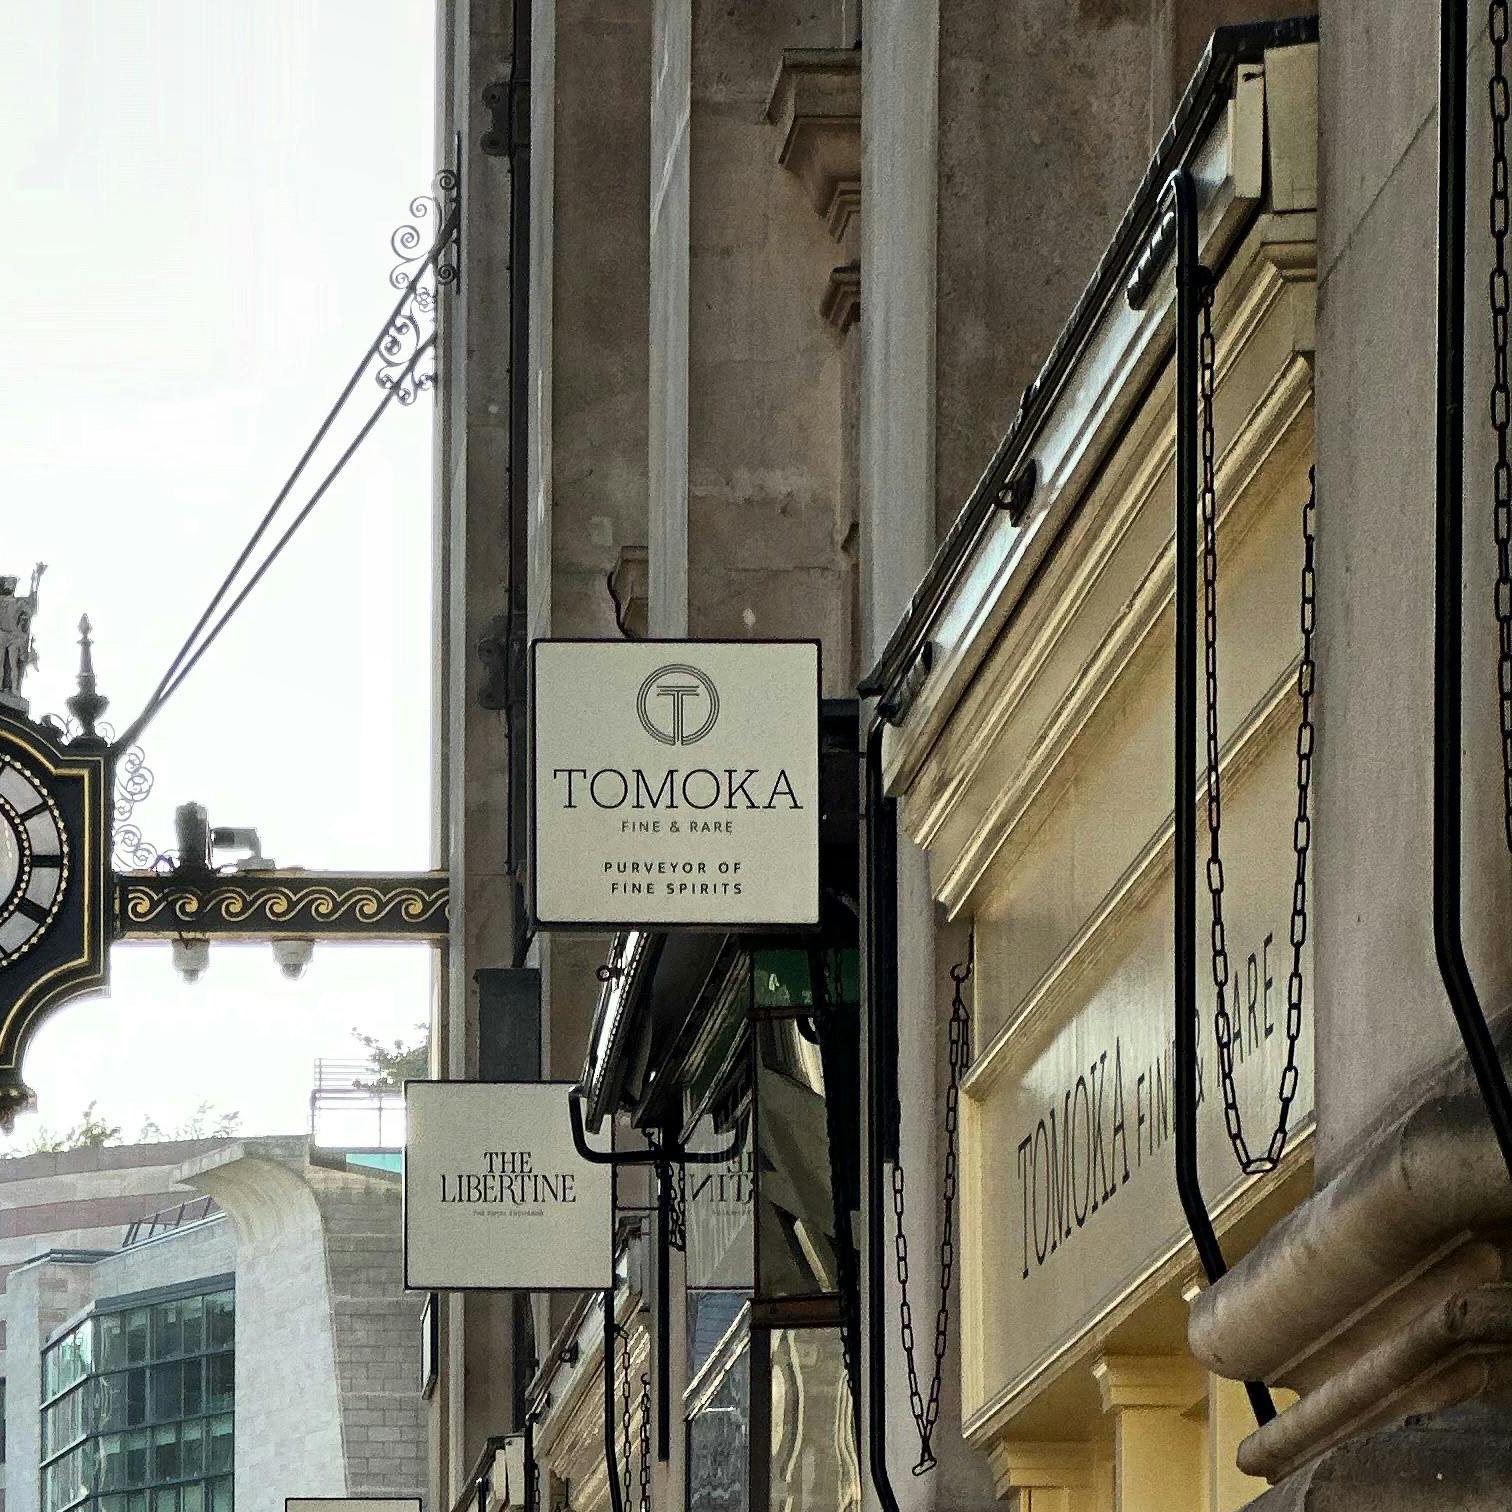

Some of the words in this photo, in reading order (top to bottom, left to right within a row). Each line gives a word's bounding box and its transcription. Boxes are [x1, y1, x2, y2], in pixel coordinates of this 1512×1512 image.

[553, 768, 804, 810] TOMOKA
[621, 821, 661, 833] FINE
[670, 821, 681, 833] &
[689, 821, 734, 834] RARE
[604, 862, 707, 874] PURVEYOR
[718, 862, 742, 874] OF
[611, 883, 656, 895] FINE
[666, 883, 743, 895] SPIRITS
[484, 1152, 532, 1173] THE
[1017, 1036, 1131, 1280] TOMOKA
[1137, 1038, 1177, 1167] FIN
[441, 1174, 577, 1206] LIBERTINE
